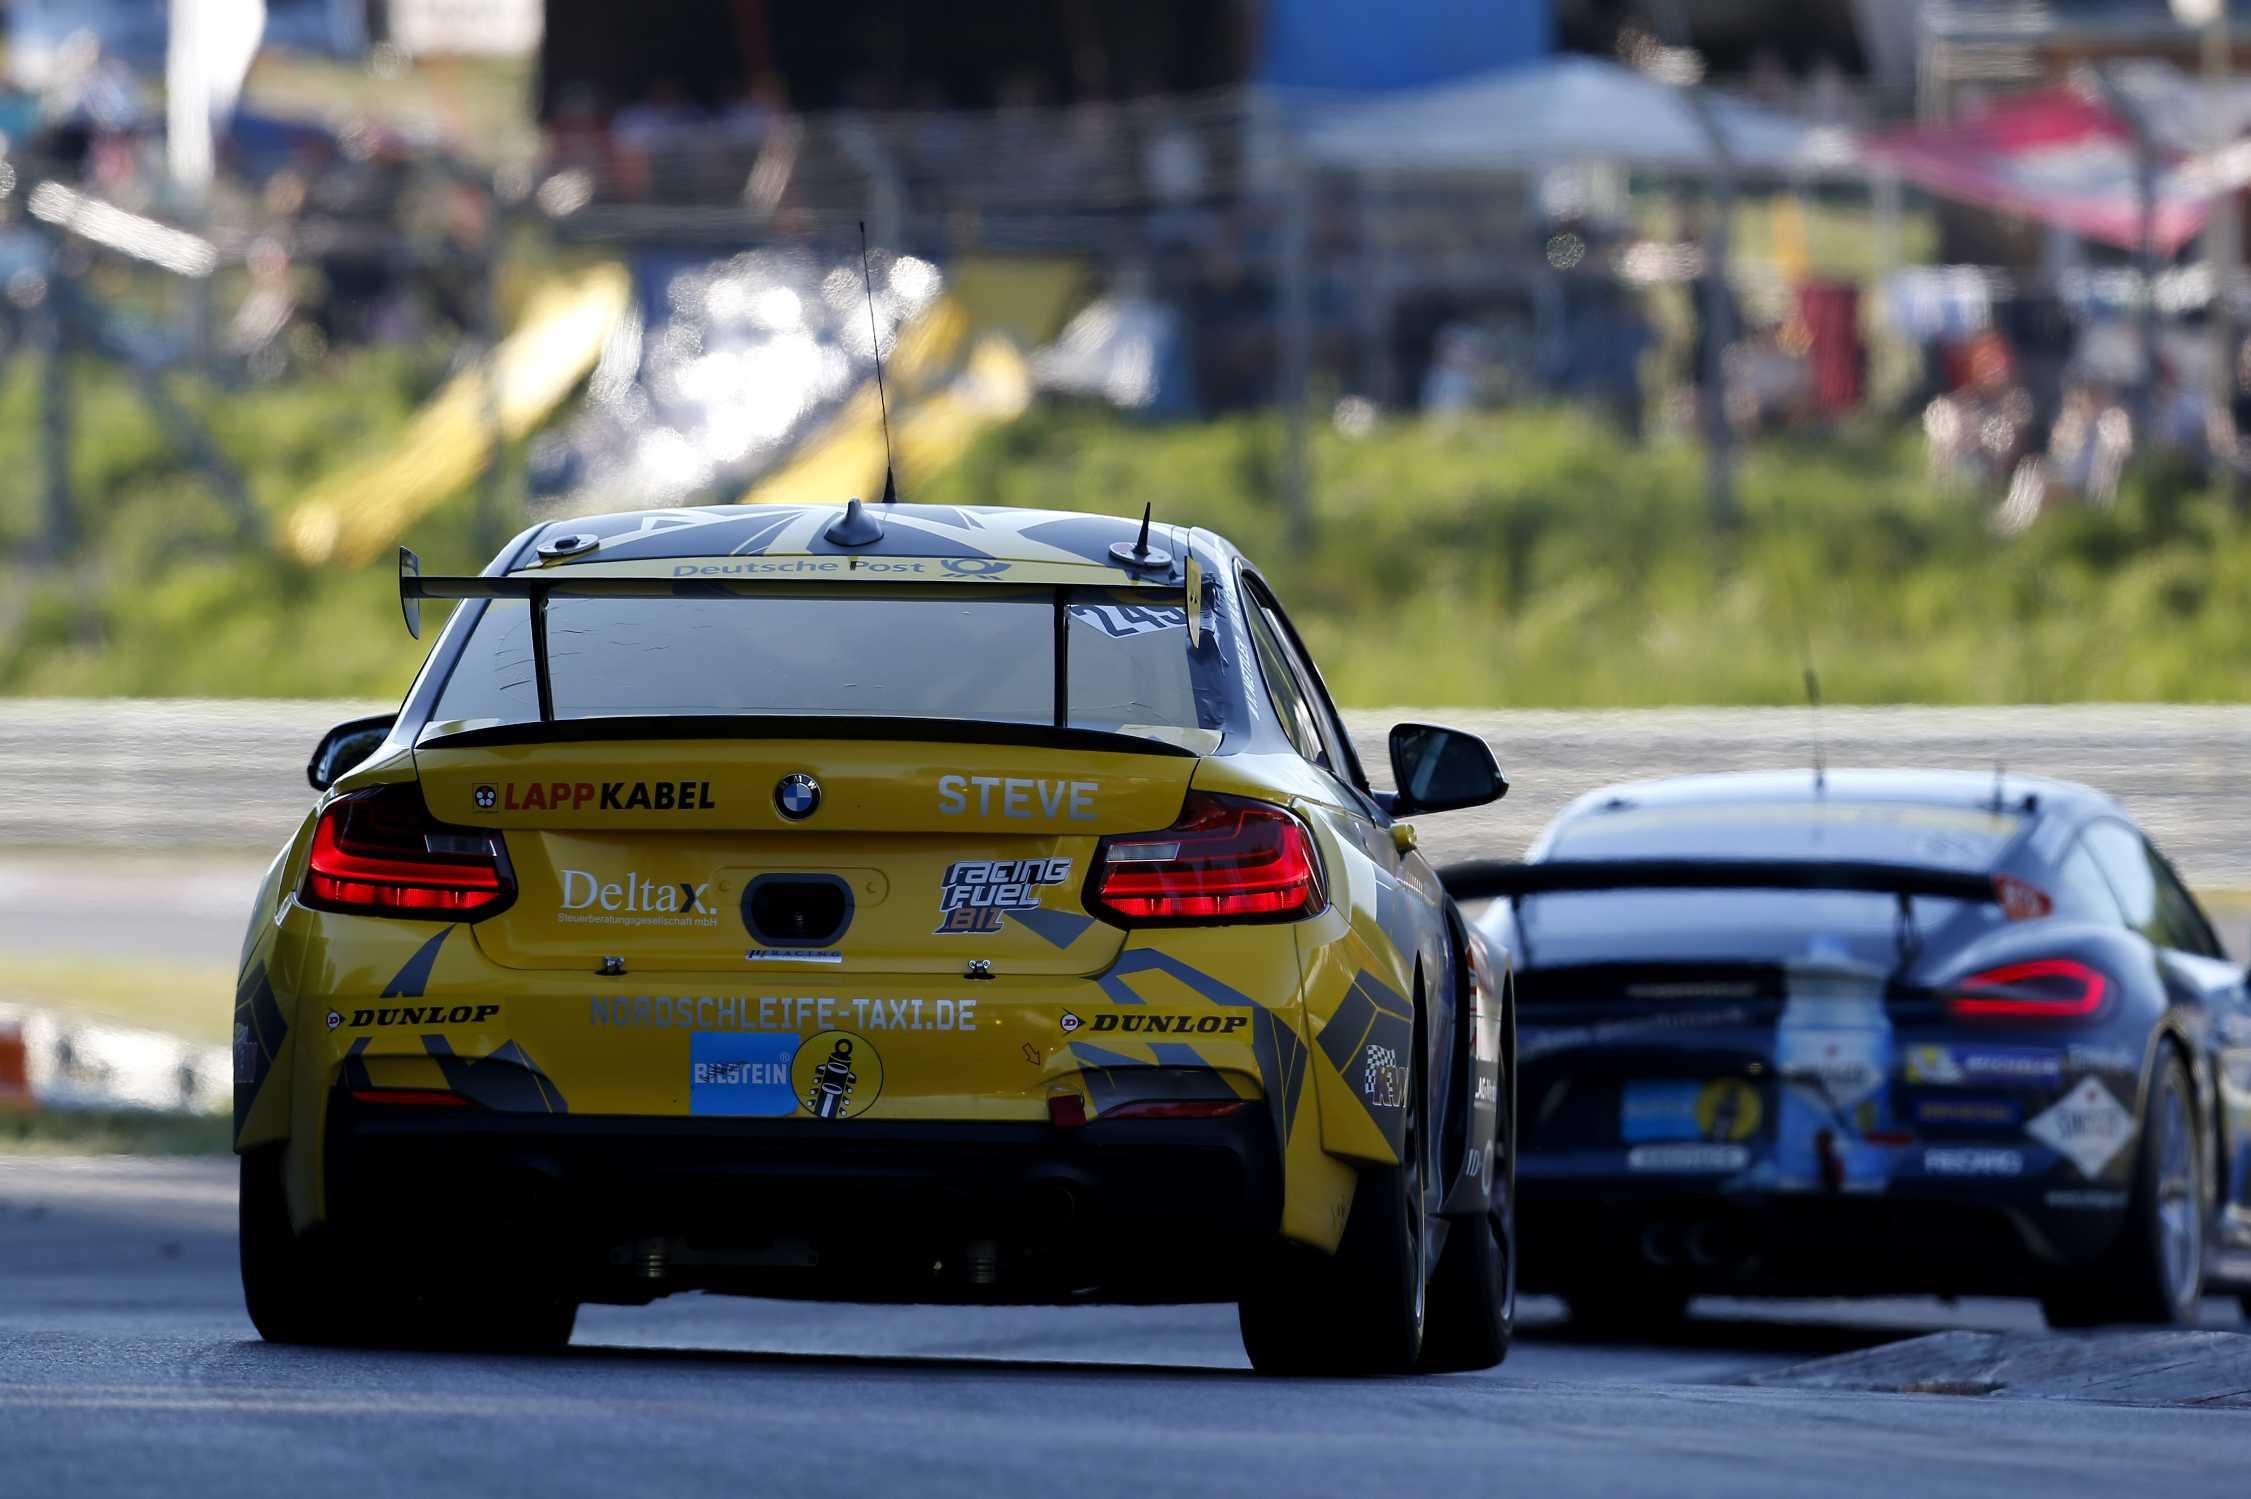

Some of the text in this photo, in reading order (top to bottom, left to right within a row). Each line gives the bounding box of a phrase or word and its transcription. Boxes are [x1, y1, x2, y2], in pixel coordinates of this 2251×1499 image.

[674, 561, 924, 576] Deutsche Post
[938, 775, 1098, 820] STEVE
[349, 1004, 499, 1027] DUNLOP
[590, 997, 977, 1031] NORDSCHLEIFE-TAXI.DE
[1089, 1014, 1248, 1034] DUNLOP
